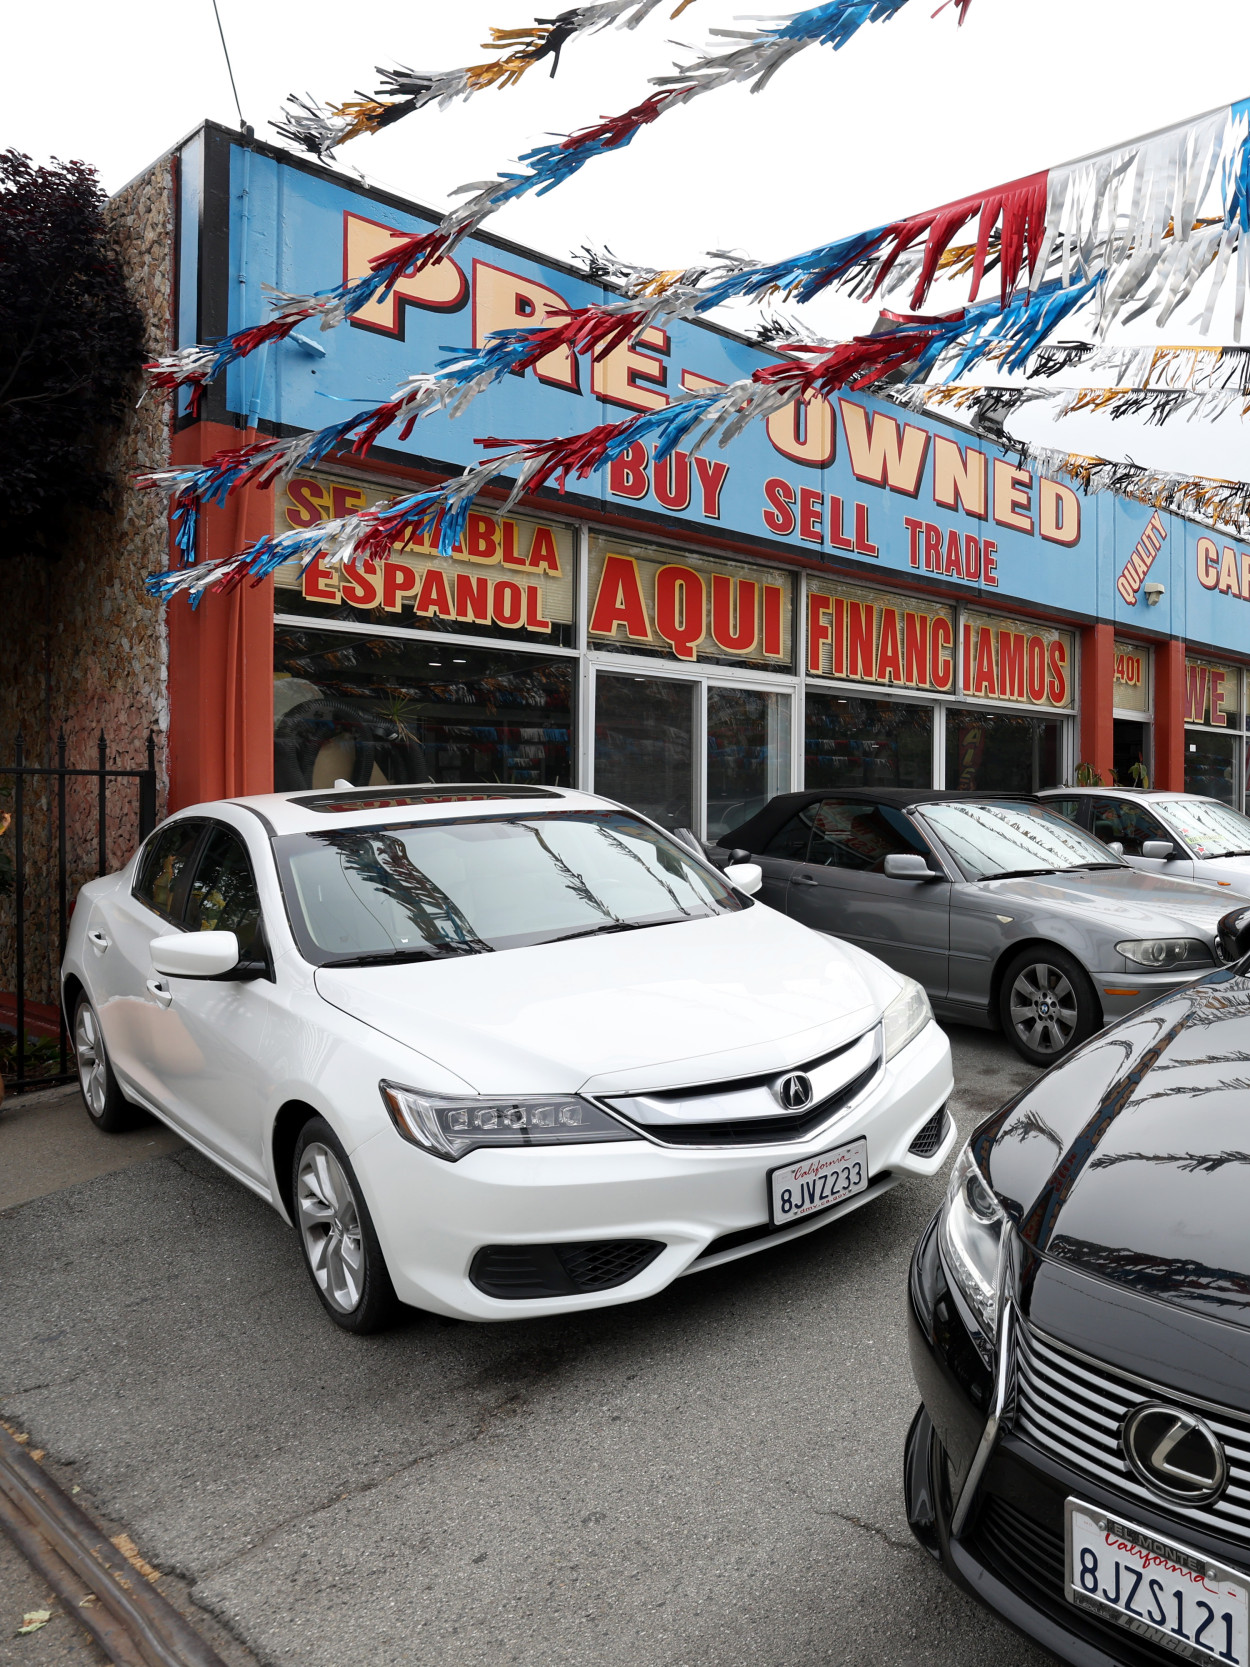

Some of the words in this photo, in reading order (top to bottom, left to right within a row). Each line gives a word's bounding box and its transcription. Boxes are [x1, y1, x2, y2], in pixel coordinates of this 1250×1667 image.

[391, 496, 562, 577] ABLA
[608, 440, 730, 519] BUY
[763, 477, 878, 557] SELL
[904, 516, 998, 587] TRADE
[302, 551, 551, 633] ESPANOL
[1117, 510, 1167, 606] QUALITY
[589, 553, 784, 661] AQUI
[808, 592, 1067, 707] FINANCIAMOS
[1113, 653, 1141, 686] 401
[1184, 664, 1227, 727] WE
[781, 1162, 862, 1214] 8JVZ233
[793, 1153, 851, 1180] California
[800, 1192, 847, 1214] dmv.ca.gov
[1114, 1523, 1134, 1541] EL
[1138, 1531, 1198, 1570] MONTE
[1080, 1547, 1240, 1666] 8JZS121
[1117, 1611, 1194, 1658] LONGO
